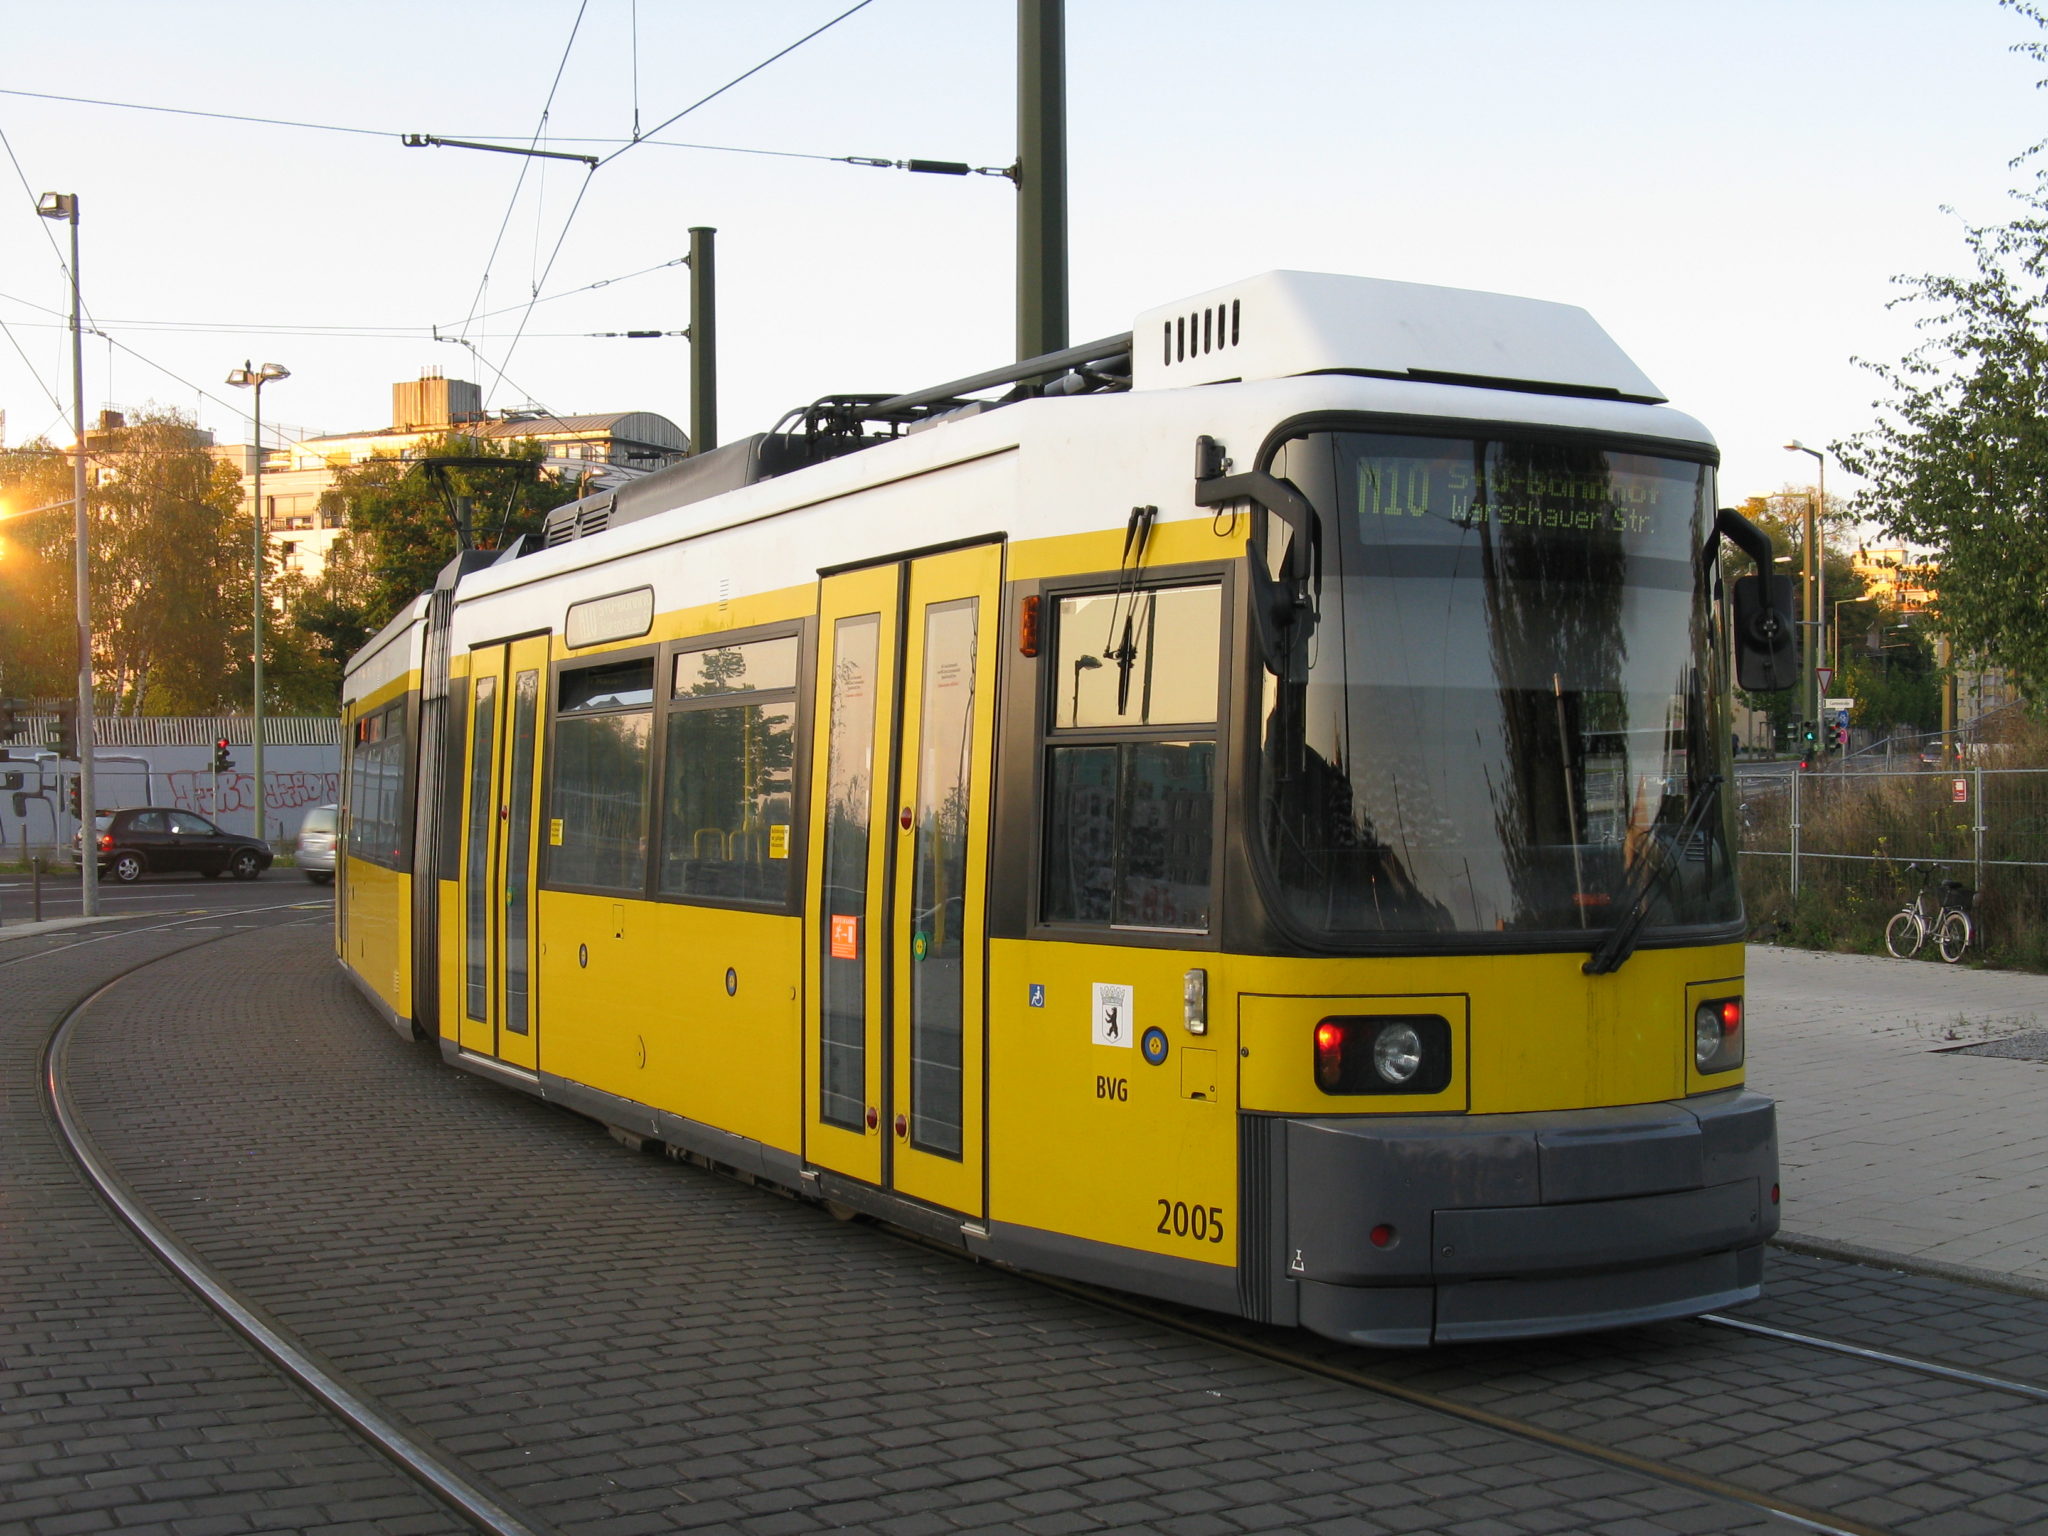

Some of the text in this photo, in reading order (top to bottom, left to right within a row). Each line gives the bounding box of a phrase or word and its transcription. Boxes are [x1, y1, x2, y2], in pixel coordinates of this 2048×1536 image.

[1358, 461, 1429, 517] N10
[1451, 494, 1655, 535] Warschauer Str.
[1096, 1075, 1128, 1102] BVG
[1157, 1198, 1224, 1244] 2005
